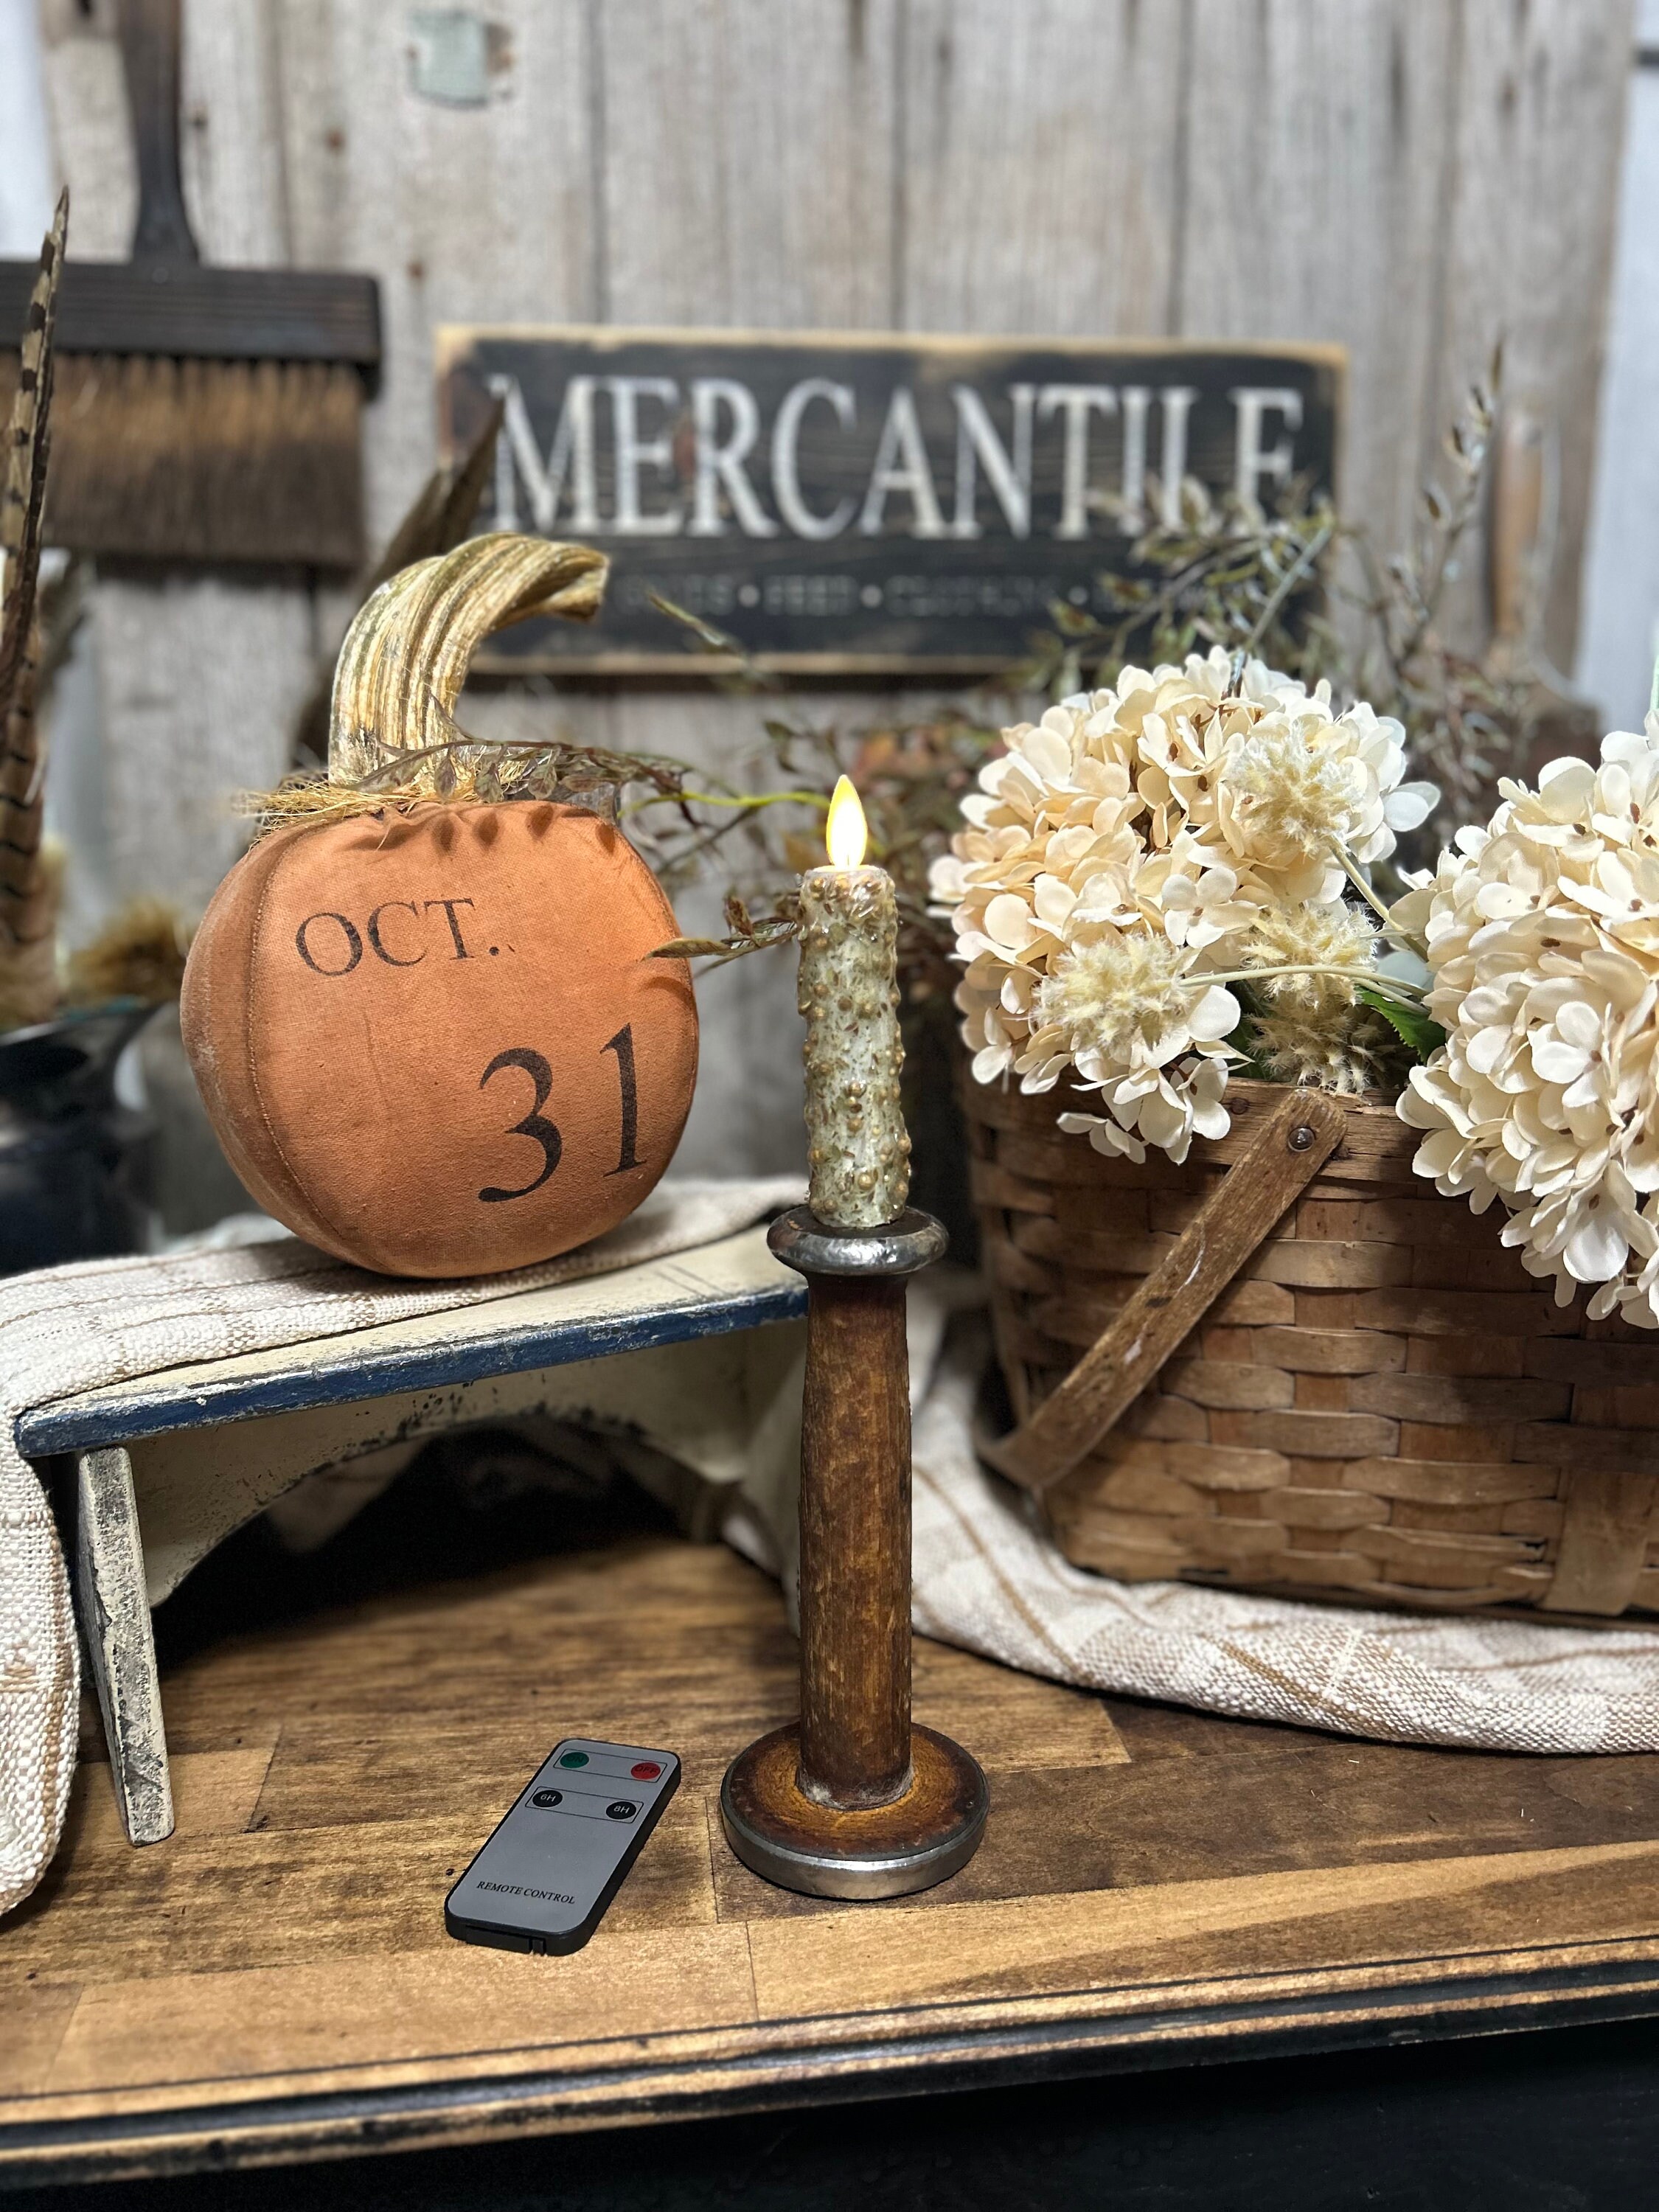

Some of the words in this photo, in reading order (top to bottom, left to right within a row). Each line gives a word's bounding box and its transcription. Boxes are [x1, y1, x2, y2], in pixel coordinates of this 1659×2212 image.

[296, 897, 500, 977] OCT.
[478, 1023, 647, 1203] 31
[566, 1755, 585, 1764] ON
[635, 1764, 658, 1774] OFF
[540, 1793, 556, 1803] 6H
[613, 1805, 630, 1814] 8H
[476, 1880, 524, 1895] REMOTE
[524, 1888, 576, 1905] CONTROL
